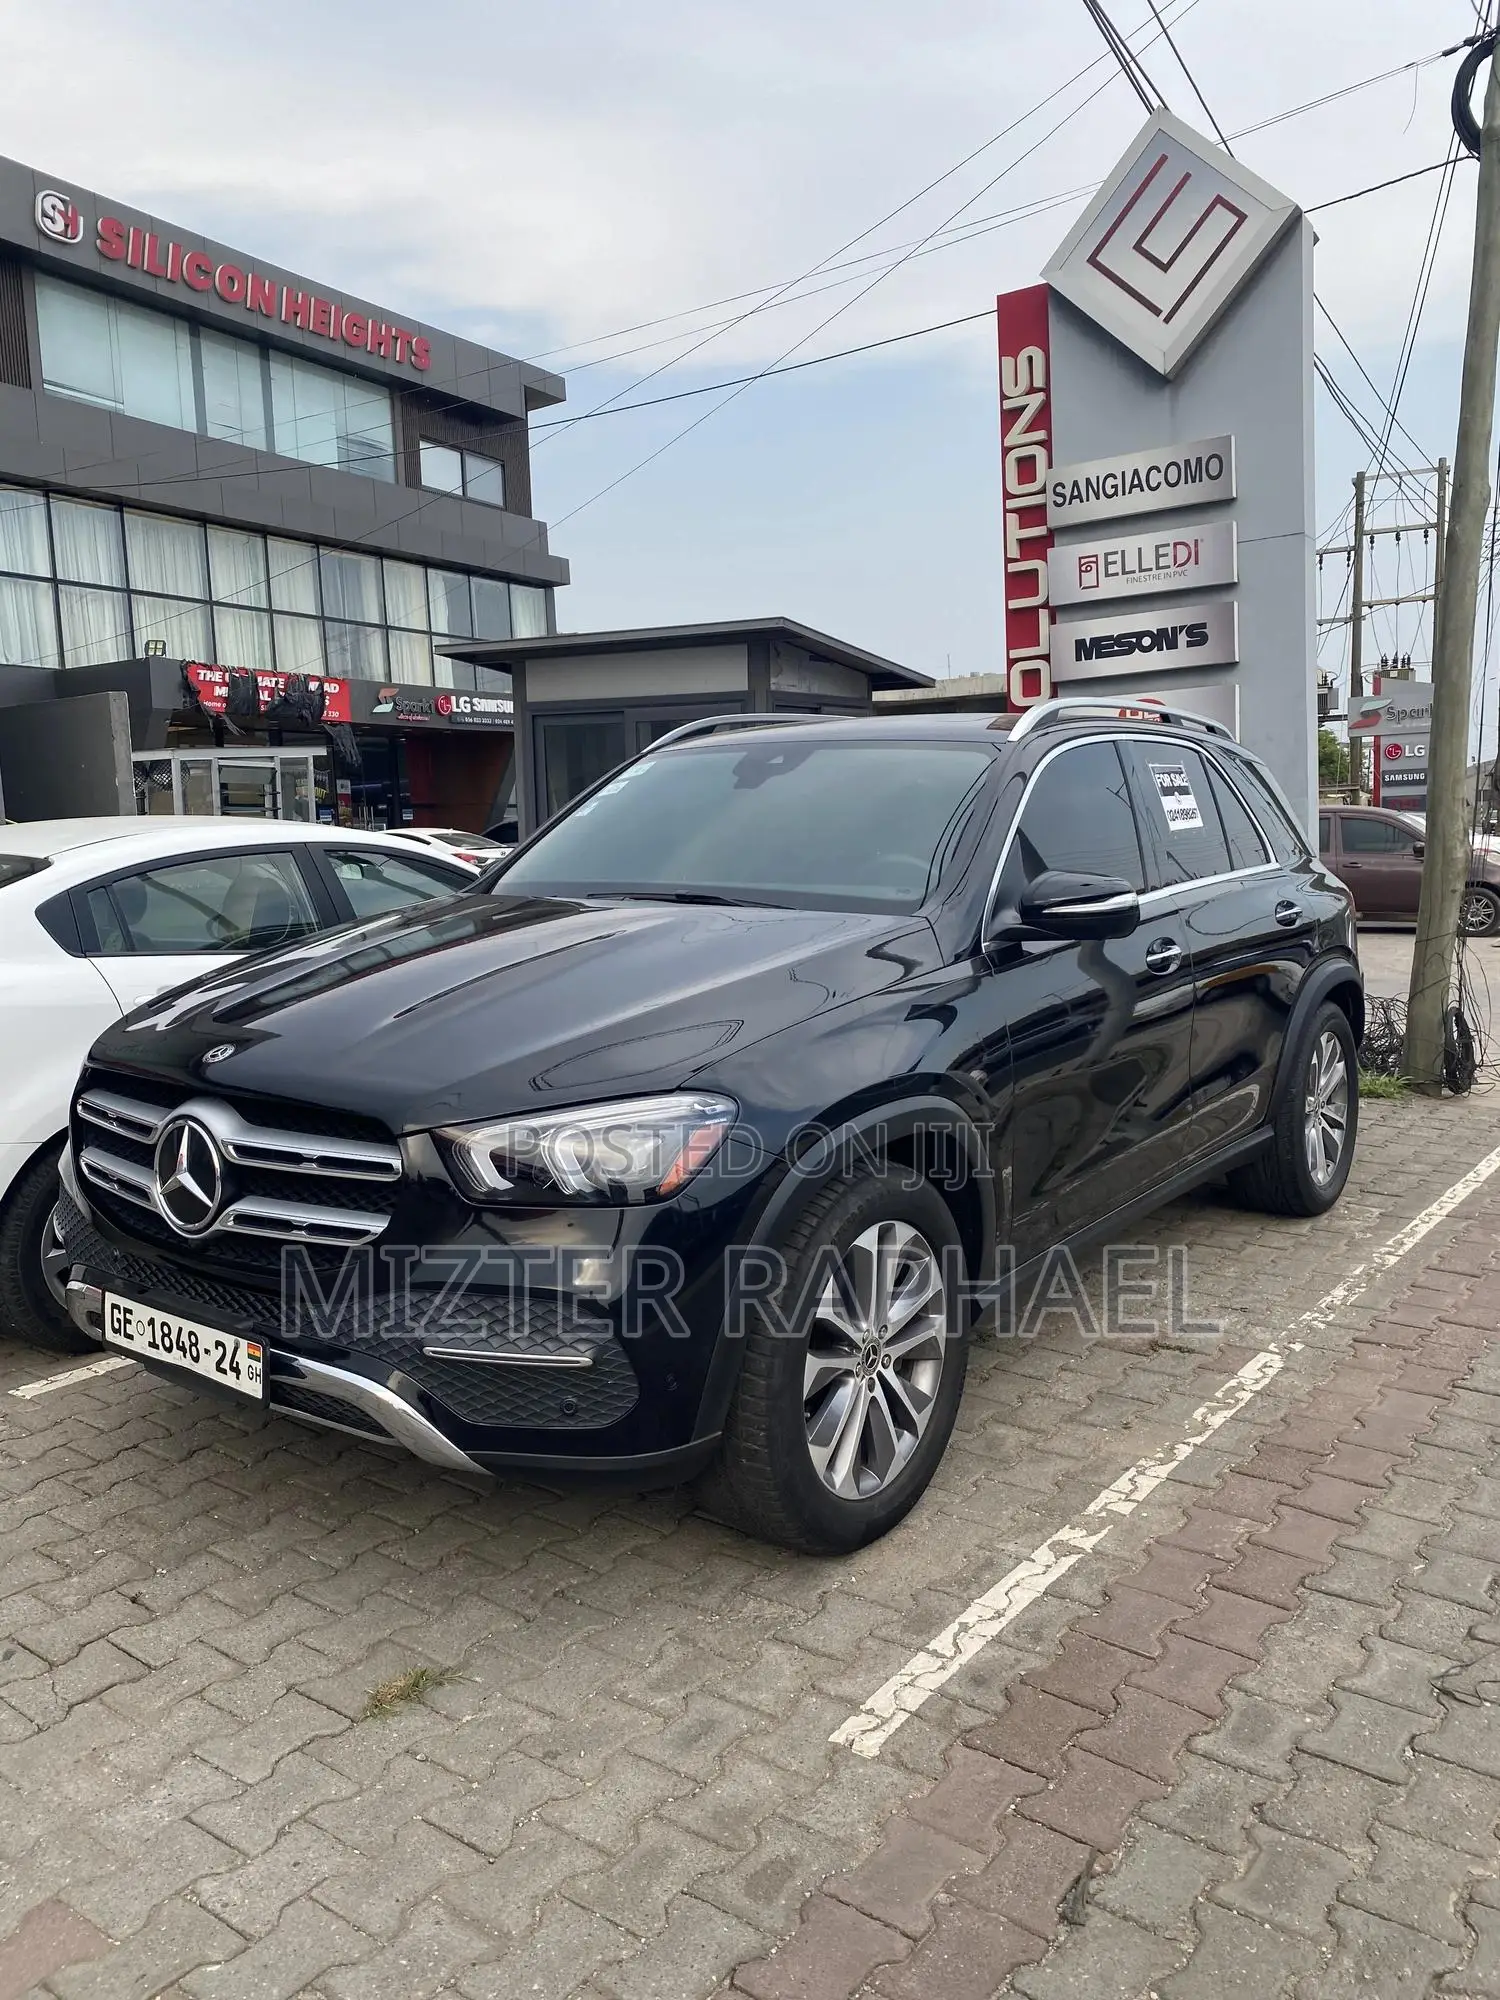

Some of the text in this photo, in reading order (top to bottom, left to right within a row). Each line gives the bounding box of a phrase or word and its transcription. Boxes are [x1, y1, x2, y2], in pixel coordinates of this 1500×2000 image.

[95, 216, 431, 372] SILICON HEIGHTS
[1052, 453, 1224, 508] SANGIACOMO
[1103, 539, 1199, 578] ELLEDI
[1126, 569, 1188, 585] FINESTRE IN PVC
[1074, 622, 1209, 662] MESON'S
[197, 669, 223, 683] THE
[450, 695, 472, 713] LG
[472, 697, 514, 714] SAMSU
[1405, 744, 1426, 757] LG
[1155, 772, 1189, 788] FOR SALE
[1384, 772, 1426, 782] SAMSUNG
[110, 1302, 242, 1381] GE 1848-24
[247, 1364, 263, 1385] GH
